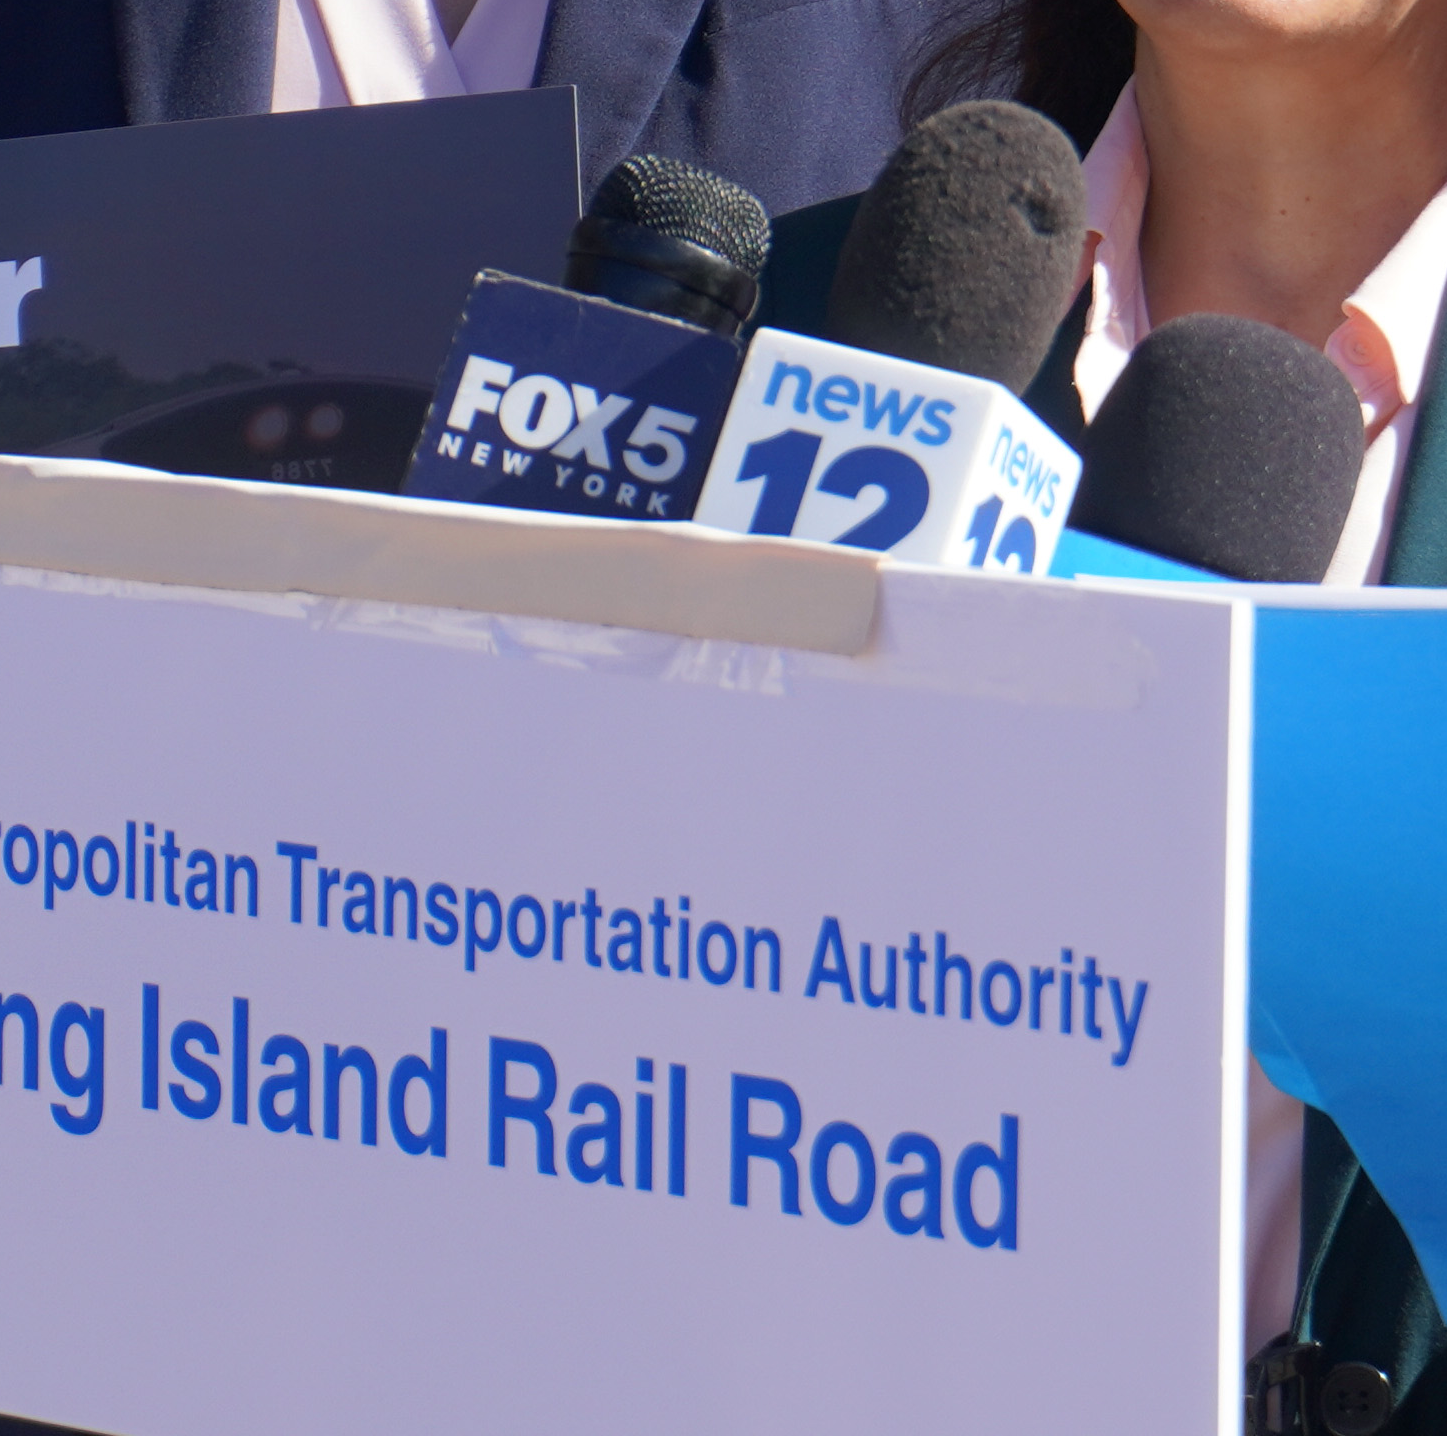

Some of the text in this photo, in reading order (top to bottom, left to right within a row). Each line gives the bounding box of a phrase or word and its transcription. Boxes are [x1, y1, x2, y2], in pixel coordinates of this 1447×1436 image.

[763, 361, 956, 447] news
[437, 432, 671, 516] NEW YORK
[736, 428, 930, 551] 12
[990, 423, 1061, 518] news
[276, 840, 782, 994] Transportation
[803, 915, 1149, 1069] Authority
[142, 982, 448, 1159] Island
[488, 1035, 687, 1198] Rail
[729, 1071, 1020, 1252] Road
